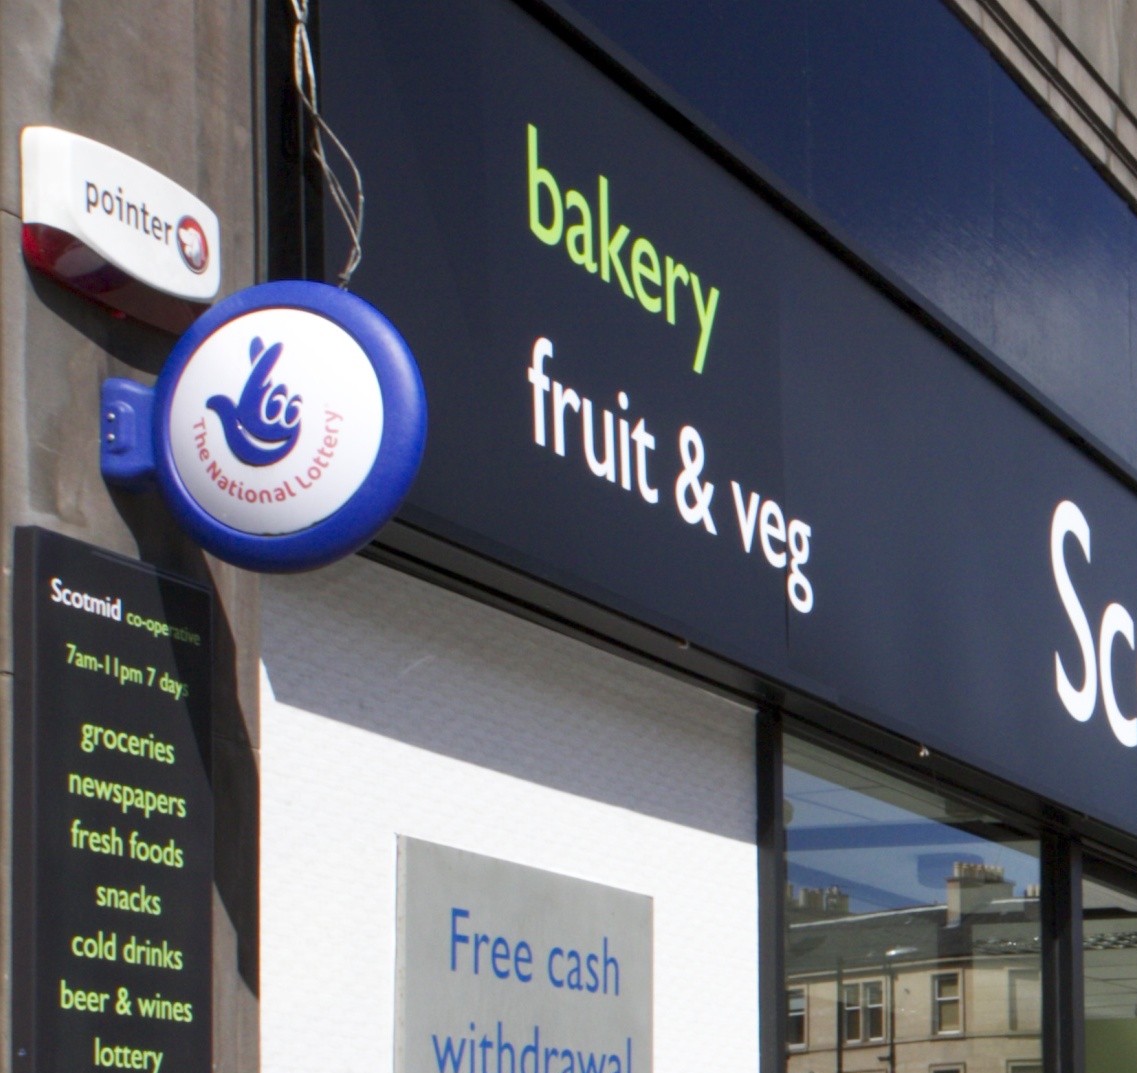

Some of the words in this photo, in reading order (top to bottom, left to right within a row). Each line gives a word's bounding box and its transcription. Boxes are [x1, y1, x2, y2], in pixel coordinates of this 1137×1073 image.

[85, 179, 172, 246] pointer
[527, 123, 720, 375] bakery
[193, 417, 210, 464] The
[206, 461, 297, 504] National
[298, 408, 344, 490] Lottery
[528, 337, 659, 503] fruit
[675, 425, 717, 535] &
[731, 481, 814, 614] veg
[51, 578, 121, 622] Scotmid
[126, 610, 201, 645] co-operative
[66, 643, 143, 685] 7am-11pm
[147, 667, 156, 686] 7
[160, 673, 189, 700] days
[80, 723, 175, 764] groceries
[68, 772, 187, 818] newspapers
[70, 819, 123, 857] fresh
[129, 831, 184, 868] foods
[96, 885, 162, 915] snacks
[71, 931, 117, 961] cold
[123, 936, 183, 970] drinks
[450, 907, 533, 983] Free
[547, 936, 620, 996] cash
[59, 979, 110, 1014] beer
[115, 987, 132, 1015] &
[137, 993, 193, 1023] wines
